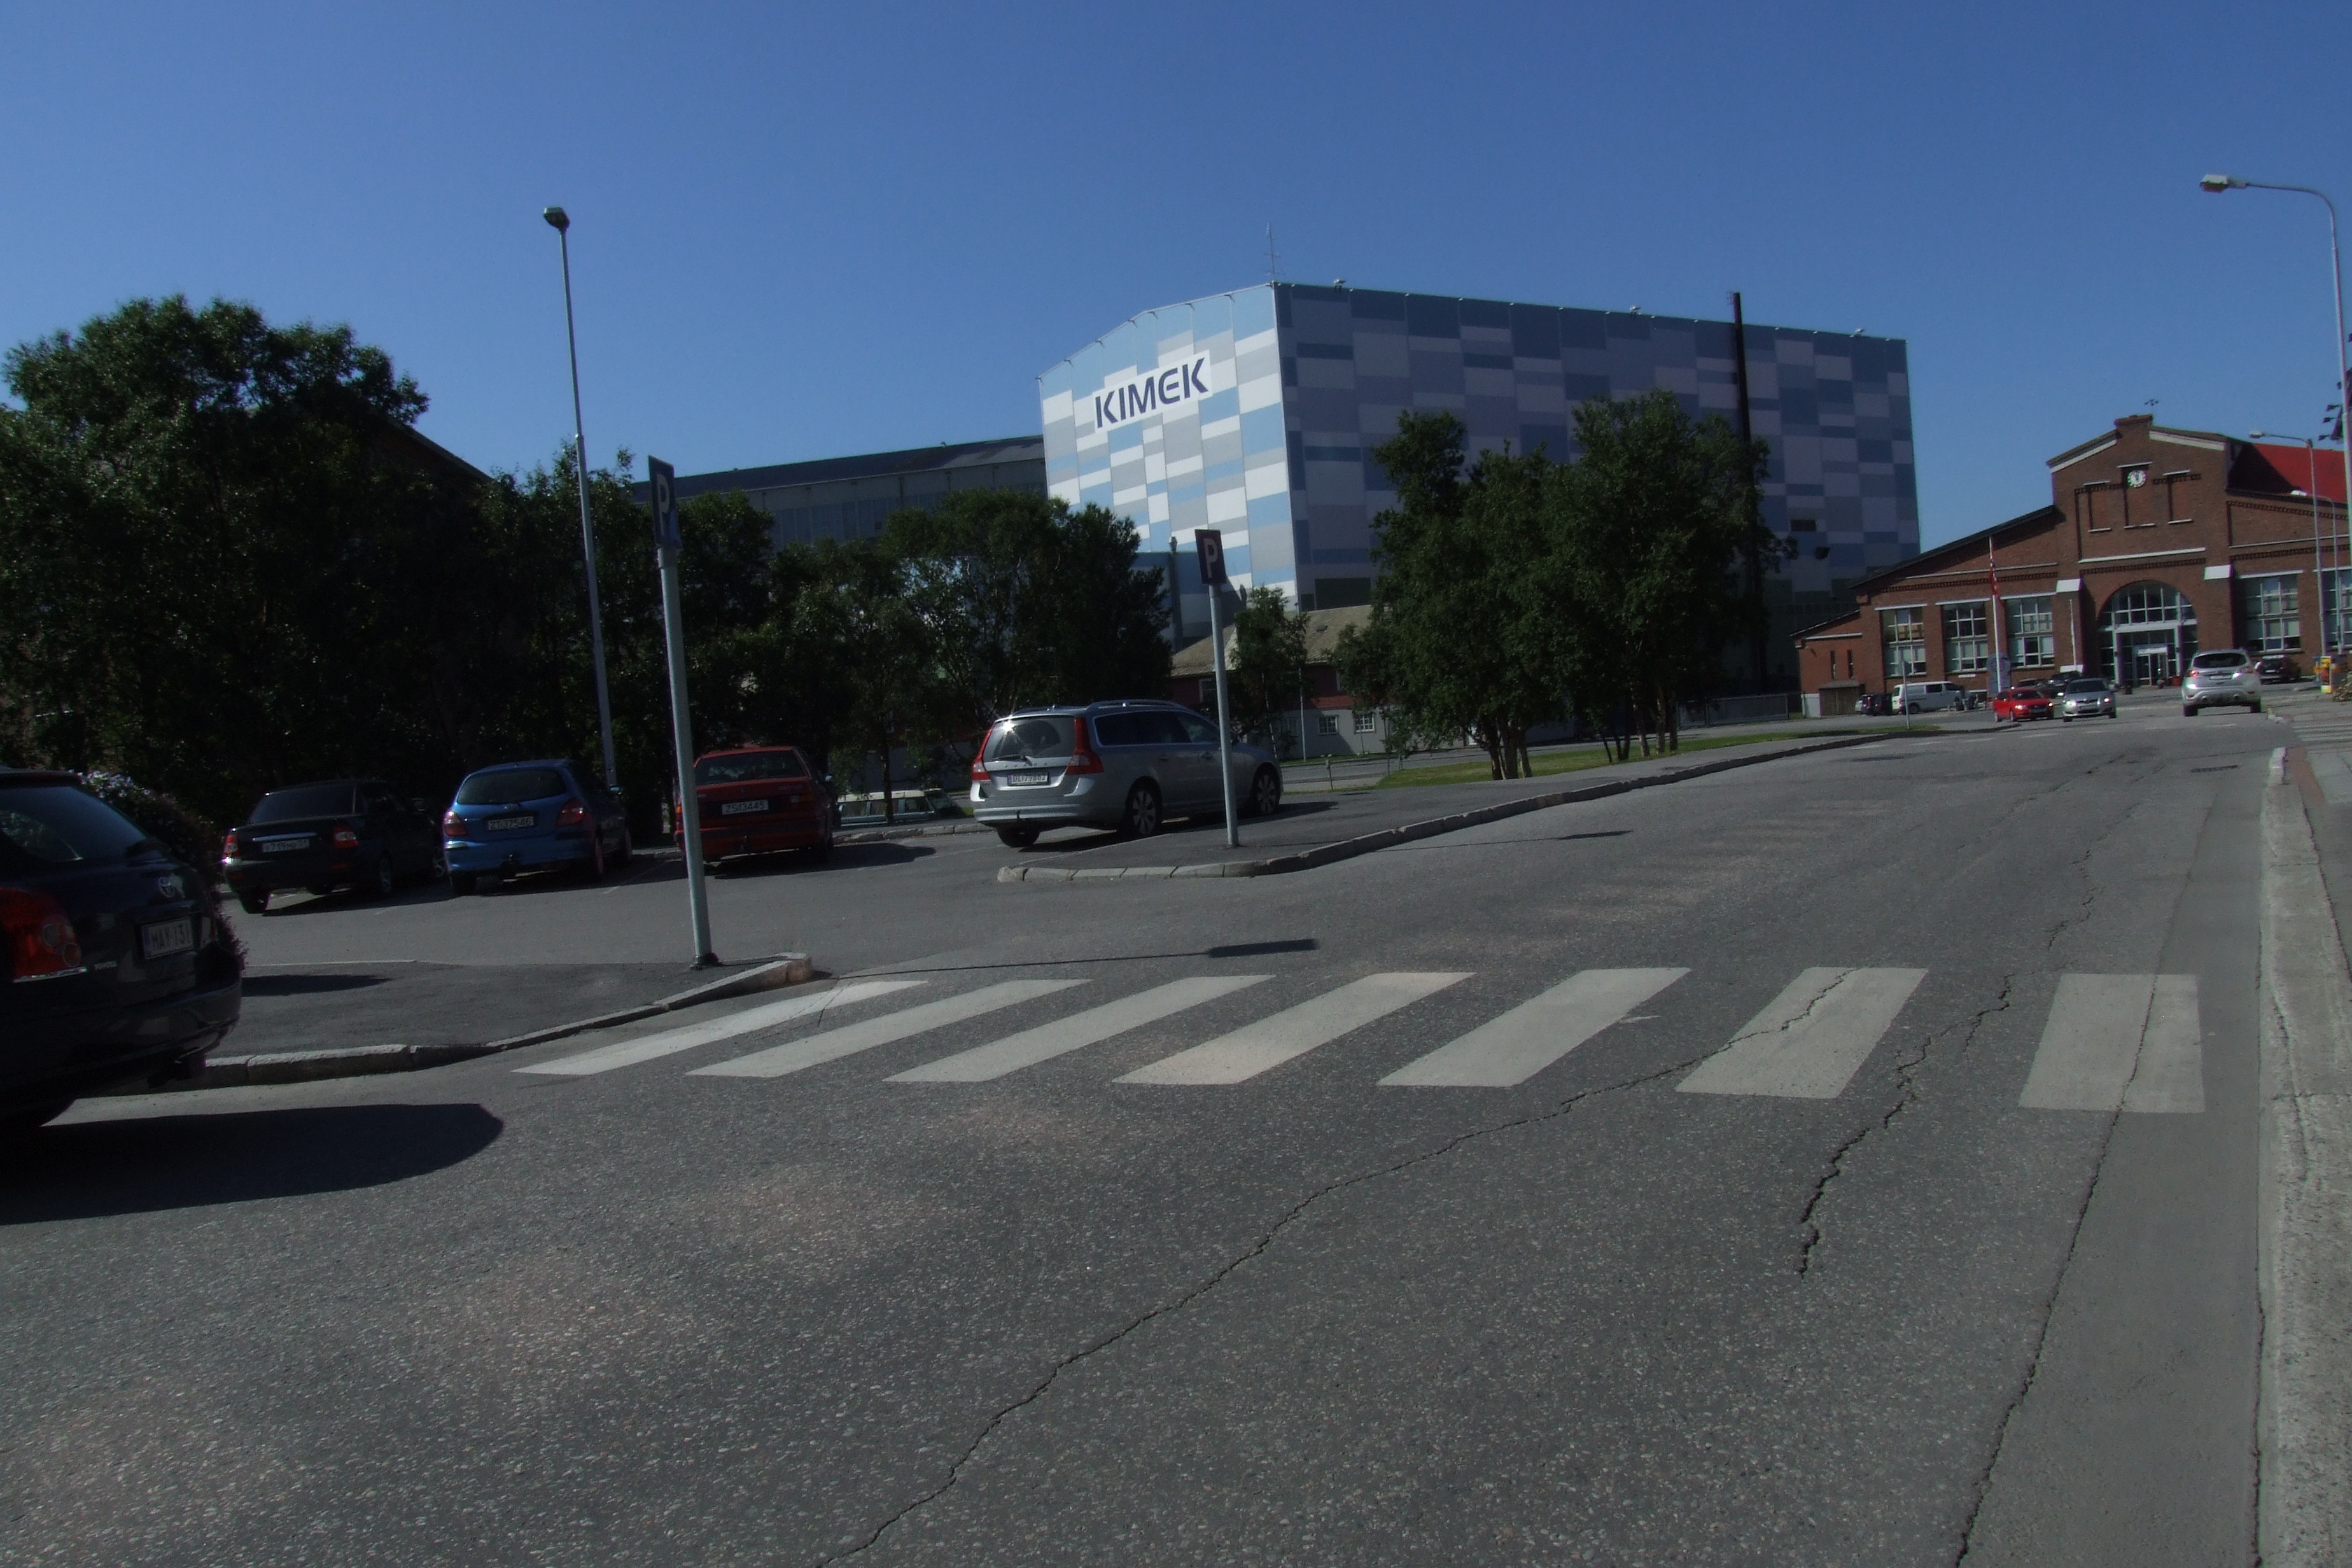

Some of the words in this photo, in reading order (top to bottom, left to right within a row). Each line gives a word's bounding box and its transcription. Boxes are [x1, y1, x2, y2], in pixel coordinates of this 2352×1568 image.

[1095, 357, 1209, 429] KIMEK
[657, 473, 670, 536] P
[1203, 538, 1218, 578] P
